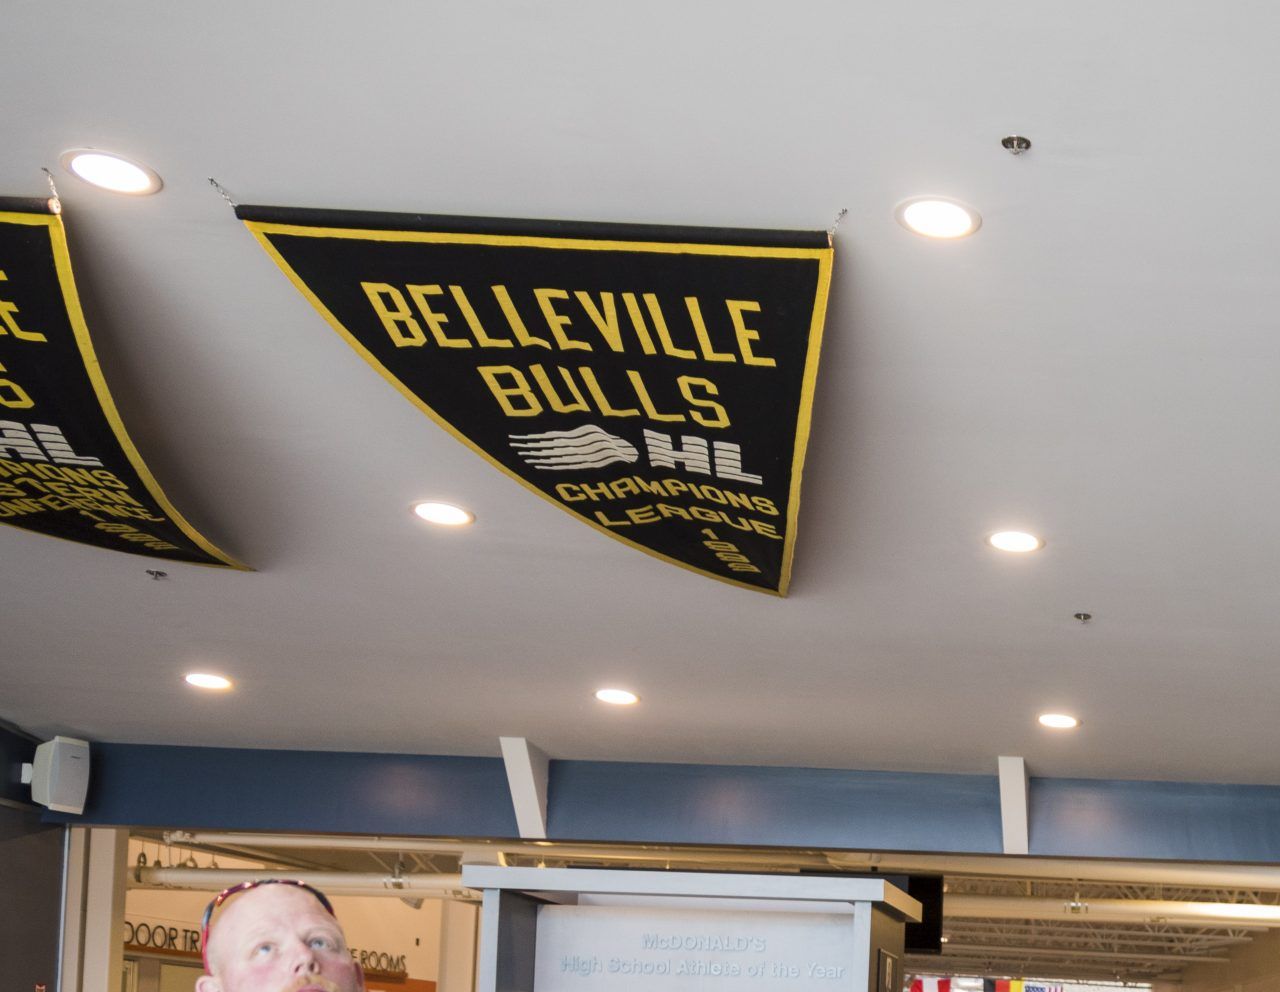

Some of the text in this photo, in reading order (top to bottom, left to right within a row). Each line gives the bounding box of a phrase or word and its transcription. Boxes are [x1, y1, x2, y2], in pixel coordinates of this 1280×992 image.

[360, 282, 776, 367] BELLEVILLE
[477, 363, 731, 429] BULLS
[0, 419, 104, 467] HL
[0, 459, 129, 490] PIONS
[0, 477, 143, 507] STERN
[555, 475, 780, 516] CHAMPIONS
[594, 503, 783, 539] LEAGUE
[182, 929, 203, 953] TR
[643, 933, 767, 952] McDONALD'S
[360, 950, 407, 975] ROOMS
[560, 955, 846, 979] High School Athlete of the Year
